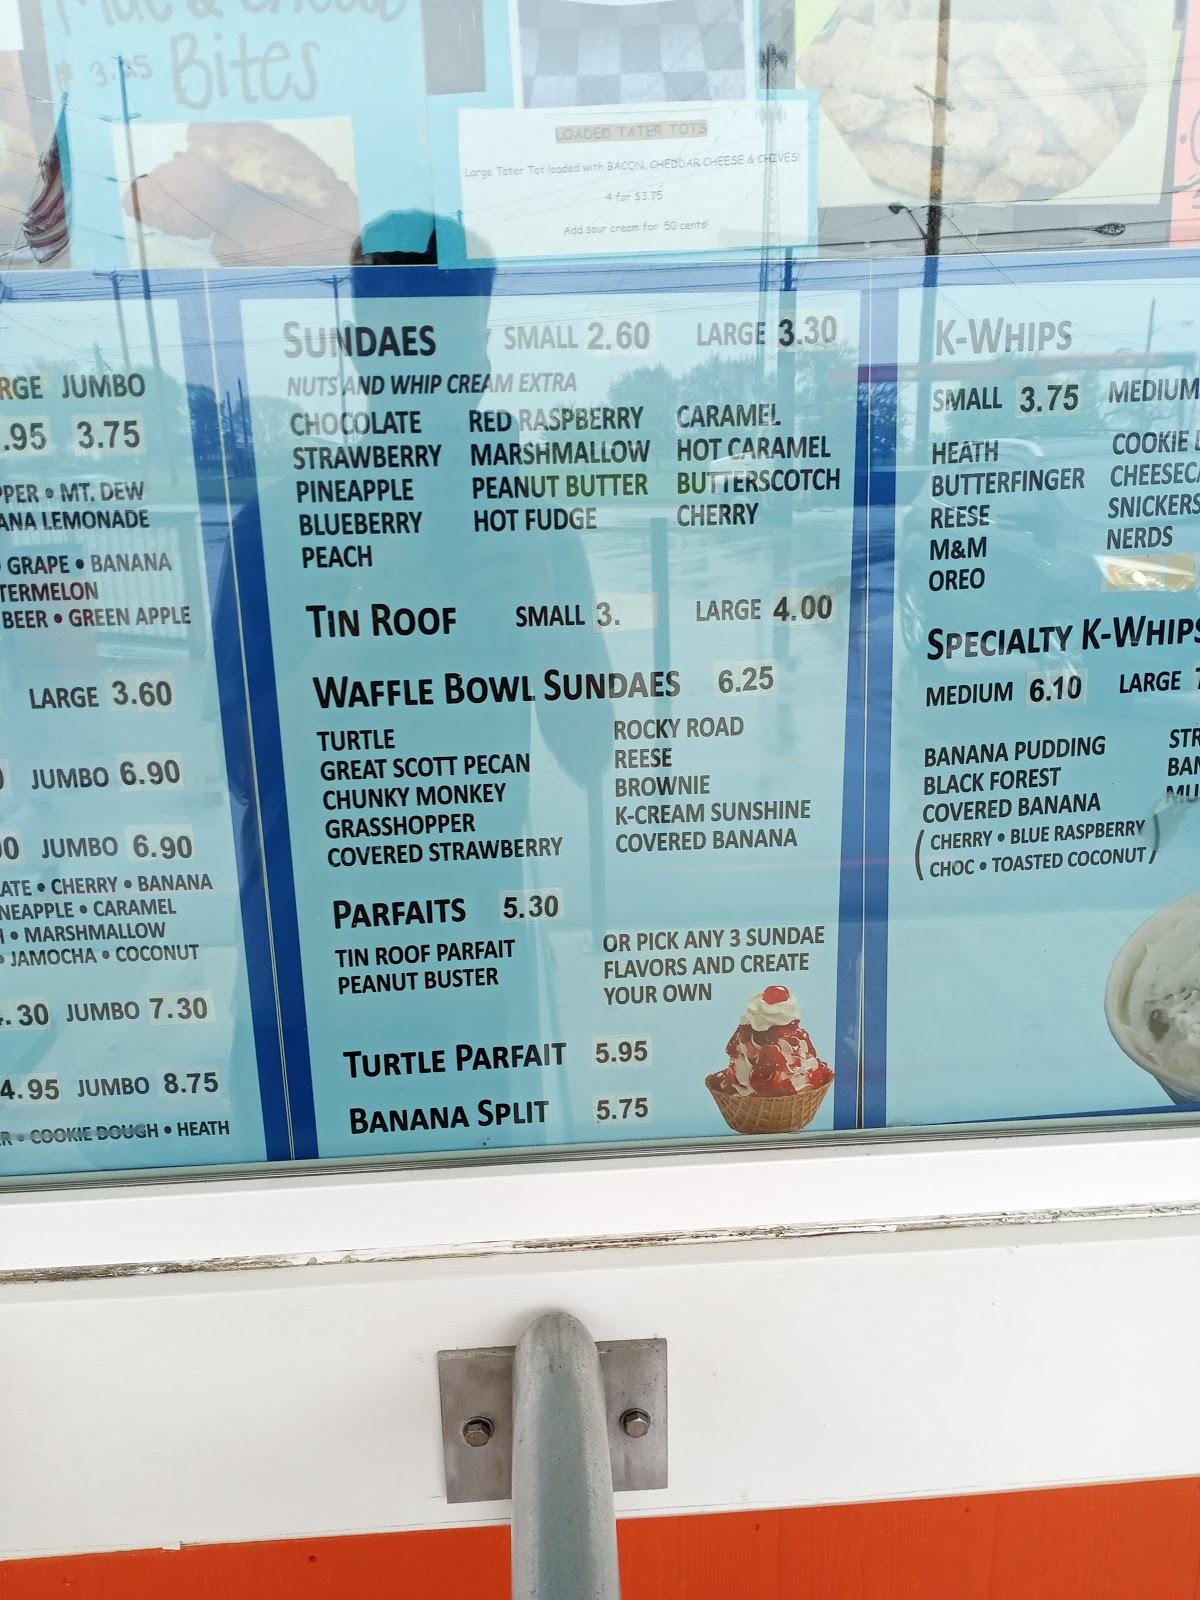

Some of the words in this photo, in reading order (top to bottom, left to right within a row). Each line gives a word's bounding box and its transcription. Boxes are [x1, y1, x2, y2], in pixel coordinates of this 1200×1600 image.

[170, 31, 320, 110] Bites
[555, 127, 611, 141] LOADED
[617, 124, 663, 138] TATER
[670, 121, 707, 136] TOTS
[464, 167, 492, 178] Large
[496, 166, 523, 176] Tater
[548, 163, 579, 174] loaded
[703, 155, 744, 167] CHEESE
[606, 192, 613, 200] 4
[616, 192, 631, 201] for
[635, 190, 663, 201] $3.75
[564, 225, 583, 235] Add
[586, 224, 608, 234] sour
[611, 224, 640, 233] cream
[643, 222, 658, 231] for
[664, 221, 677, 230] 50
[680, 220, 708, 230] cents!
[283, 321, 436, 358] SUNDAES
[504, 325, 579, 350] SMALL
[587, 320, 650, 350] 2.60
[697, 322, 766, 346] LARGE
[778, 316, 838, 346] 3.30
[936, 318, 1072, 356] K-WHIPS
[62, 373, 146, 398] JUMBO
[287, 375, 337, 396] NUTS
[342, 375, 385, 395] AND
[391, 374, 442, 394] WHIP
[447, 373, 514, 393] CREAM
[519, 372, 577, 392] EXTRA
[932, 386, 1002, 412] SMALL
[1020, 384, 1079, 412] 3.75
[1108, 378, 1200, 404] MEDIUM
[290, 411, 422, 436] CHOCOLATE
[469, 410, 512, 432] RED
[519, 406, 643, 432] RASPBERRY
[677, 404, 781, 427] CARAMEL
[76, 420, 140, 449] 3.75
[932, 440, 998, 464] HEATH
[1112, 430, 1189, 456] COOKIE
[293, 444, 442, 470] STRAWBERRY
[471, 440, 650, 466] MARSHMALLOW
[677, 438, 721, 461] HOT
[728, 436, 830, 459] CARAMEL
[60, 483, 95, 502] MT.
[100, 482, 144, 501] DEW
[296, 479, 414, 503] PINEAPPLE
[472, 475, 559, 499] PEANUT
[566, 473, 648, 497] BUTTER
[677, 469, 840, 494] BUTTERSCOTCH
[932, 468, 1085, 497] BUTTERFINGER
[44, 510, 150, 531] LEMONADE
[299, 511, 422, 536] BLUEBERRY
[474, 509, 519, 532] HOT
[525, 507, 597, 531] FUDGE
[677, 503, 759, 527] CHERRY
[930, 504, 990, 529] REESE
[930, 536, 987, 560] M&M
[1106, 526, 1173, 550] NERDS
[8, 556, 70, 575] GRAPE
[90, 553, 172, 572] BANANA
[302, 545, 373, 569] PEACH
[929, 568, 986, 592] OREO
[2, 610, 48, 628] BEER
[68, 608, 130, 627] GREEN
[136, 606, 191, 626] APPLE
[306, 604, 360, 638] TIN
[371, 603, 456, 636] ROOF
[516, 605, 585, 627] SMALL
[596, 602, 620, 626] 3.
[696, 599, 761, 622] LARGE
[773, 595, 832, 622] 4.00
[927, 625, 1073, 660] SPECIALTY
[29, 687, 99, 709] LARGE
[112, 680, 172, 707] 3.60
[313, 676, 433, 709] WAFFLE
[445, 673, 535, 704] BOWL
[544, 669, 681, 701] SUNDAES
[719, 666, 774, 693] 6.25
[926, 682, 1013, 707] MEDIUM
[1030, 675, 1082, 703] 6.10
[1119, 671, 1181, 694] LARGE
[317, 729, 395, 751] TURTLE
[614, 719, 681, 740] ROCKY
[686, 716, 744, 737] ROAD
[615, 748, 672, 769] REESE
[924, 742, 1008, 767] BANANA
[1014, 735, 1106, 760] PUDDING
[32, 767, 109, 790] JUMBO
[120, 760, 180, 785] 6.90
[320, 759, 387, 782] GREAT
[393, 756, 457, 778] SCOTT
[464, 753, 530, 775] PECAN
[923, 773, 984, 795] BLACK
[990, 767, 1061, 790] FOREST
[323, 787, 410, 811] CHUNKY
[416, 783, 507, 806] MONKEY
[615, 775, 710, 797] BROWNIE
[615, 804, 705, 825] K-CREAM
[711, 800, 811, 822] SUNSHINE
[922, 799, 1012, 824] COVERED
[1018, 793, 1101, 816] BANANA
[325, 813, 475, 839] GRASSHOPPER
[930, 831, 993, 850] CHERRY
[1010, 826, 1050, 844] BLUE
[1054, 819, 1145, 841] RASPBERRY
[42, 836, 118, 858] JUMBO
[133, 834, 192, 859] 6.90
[327, 844, 423, 867] COVERED
[429, 836, 563, 862] STRAWBERRY
[615, 831, 706, 853] COVERED
[712, 828, 798, 849] BANANA
[930, 860, 975, 877] CHOC
[992, 853, 1063, 872] TOASTED
[1068, 847, 1147, 867] COCONUT
[51, 876, 118, 895] CHERRY
[138, 874, 213, 892] BANANA
[93, 898, 176, 917] CARAMEL
[333, 898, 466, 929] PARFAITS
[503, 895, 559, 919] 5.30
[24, 922, 166, 943] MARSHMALLOW
[603, 934, 631, 953] OR
[637, 931, 679, 951] PICK
[684, 930, 724, 948] ANY
[730, 929, 741, 947] 3
[746, 926, 825, 947] SUNDAE
[11, 948, 97, 966] JAMOCHA
[116, 944, 199, 962] COCONUT
[335, 948, 369, 968] TIN
[376, 944, 430, 965] ROOF
[437, 939, 515, 961] PARFAIT
[604, 958, 686, 979] FLAVORS
[693, 955, 734, 975] AND
[741, 953, 809, 973] CREATE
[338, 972, 418, 995] PEANUT
[424, 967, 499, 989] BUSTER
[604, 986, 657, 1005] YOUR
[663, 983, 712, 1003] OWN
[66, 1001, 140, 1023] JUMBO
[149, 997, 207, 1019] 7.30
[343, 1050, 446, 1078] TURTLE
[456, 1042, 566, 1071] PARFAIT
[595, 1041, 647, 1064] 5.95
[78, 1077, 150, 1098] JUMBO
[164, 1072, 218, 1094] 8.75
[350, 1106, 470, 1135] BANANA
[478, 1099, 549, 1126] SPLIT
[596, 1098, 648, 1120] 5.75
[30, 1128, 92, 1144] COOKIE
[96, 1124, 158, 1139] DOUGH
[177, 1121, 230, 1136] HEATH
